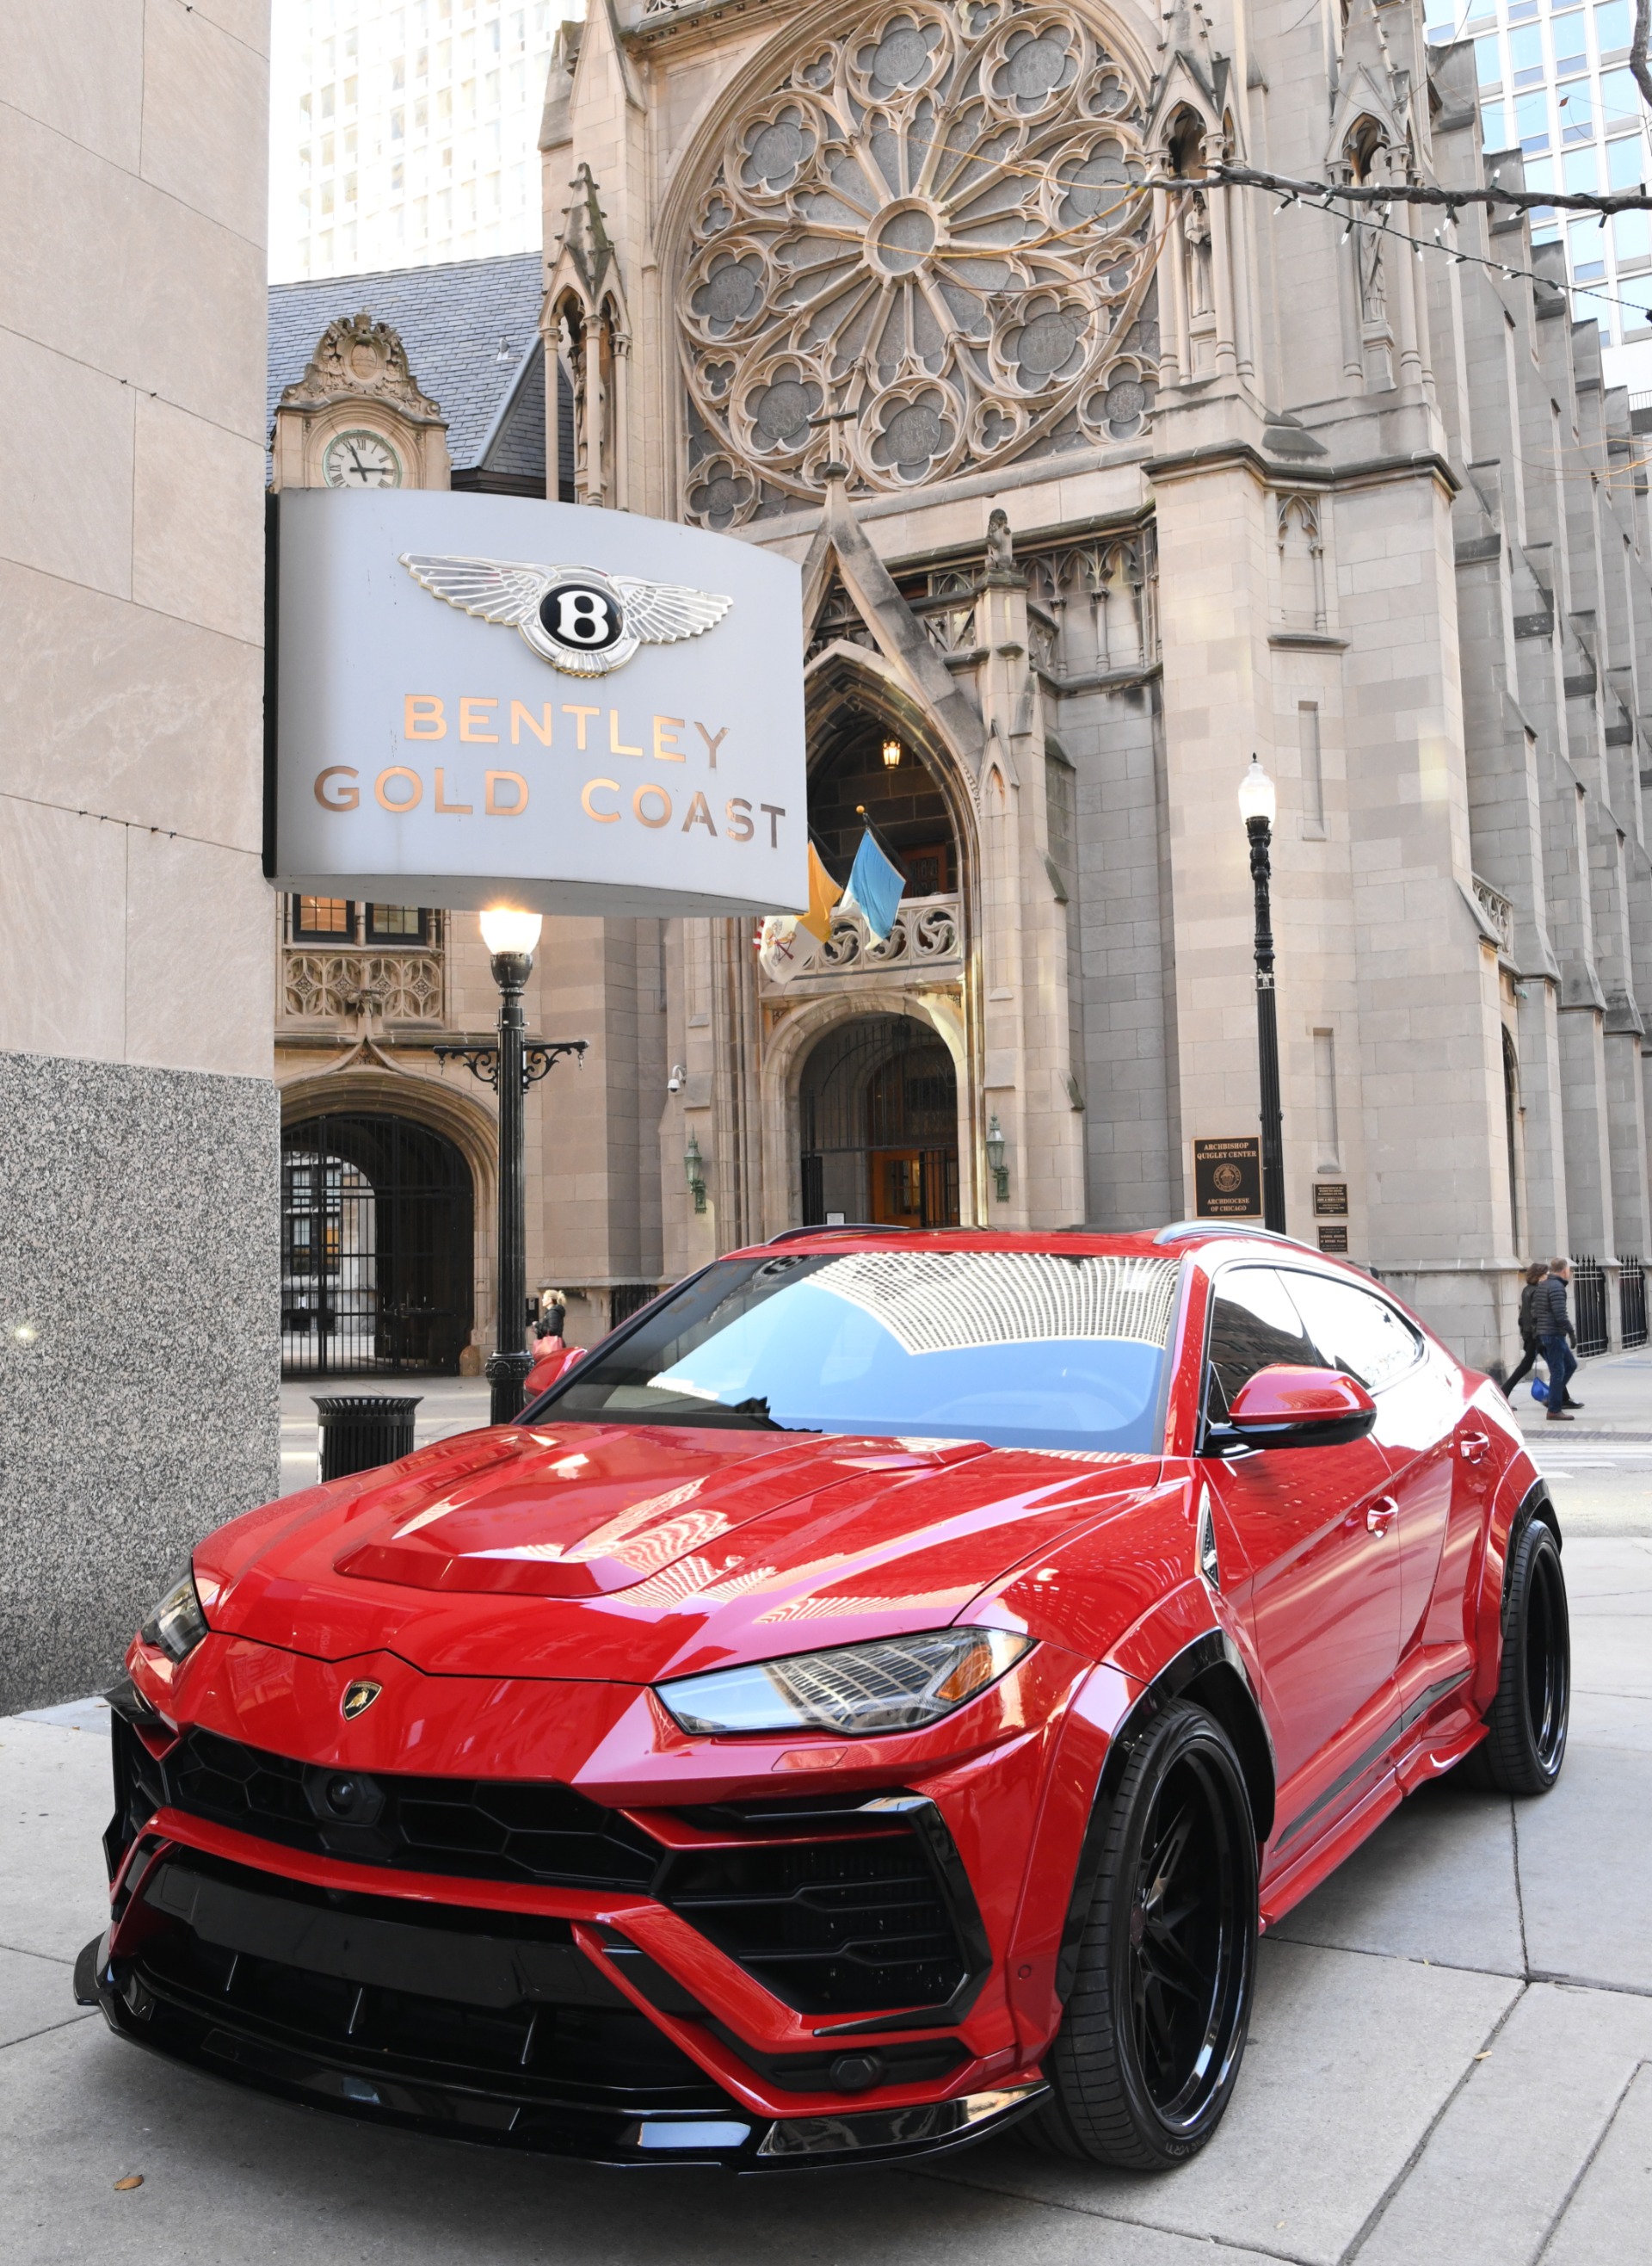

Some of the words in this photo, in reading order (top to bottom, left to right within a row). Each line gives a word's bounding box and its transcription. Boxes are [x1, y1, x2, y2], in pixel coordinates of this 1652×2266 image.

[356, 439, 367, 451] XII
[557, 590, 609, 644] B
[404, 694, 730, 769] BENTLEY
[314, 765, 529, 816] GOLD
[581, 778, 786, 849] COAST
[1197, 1152, 1228, 1160] QUIGLEY
[1204, 1142, 1249, 1151] ARCHBISHOP
